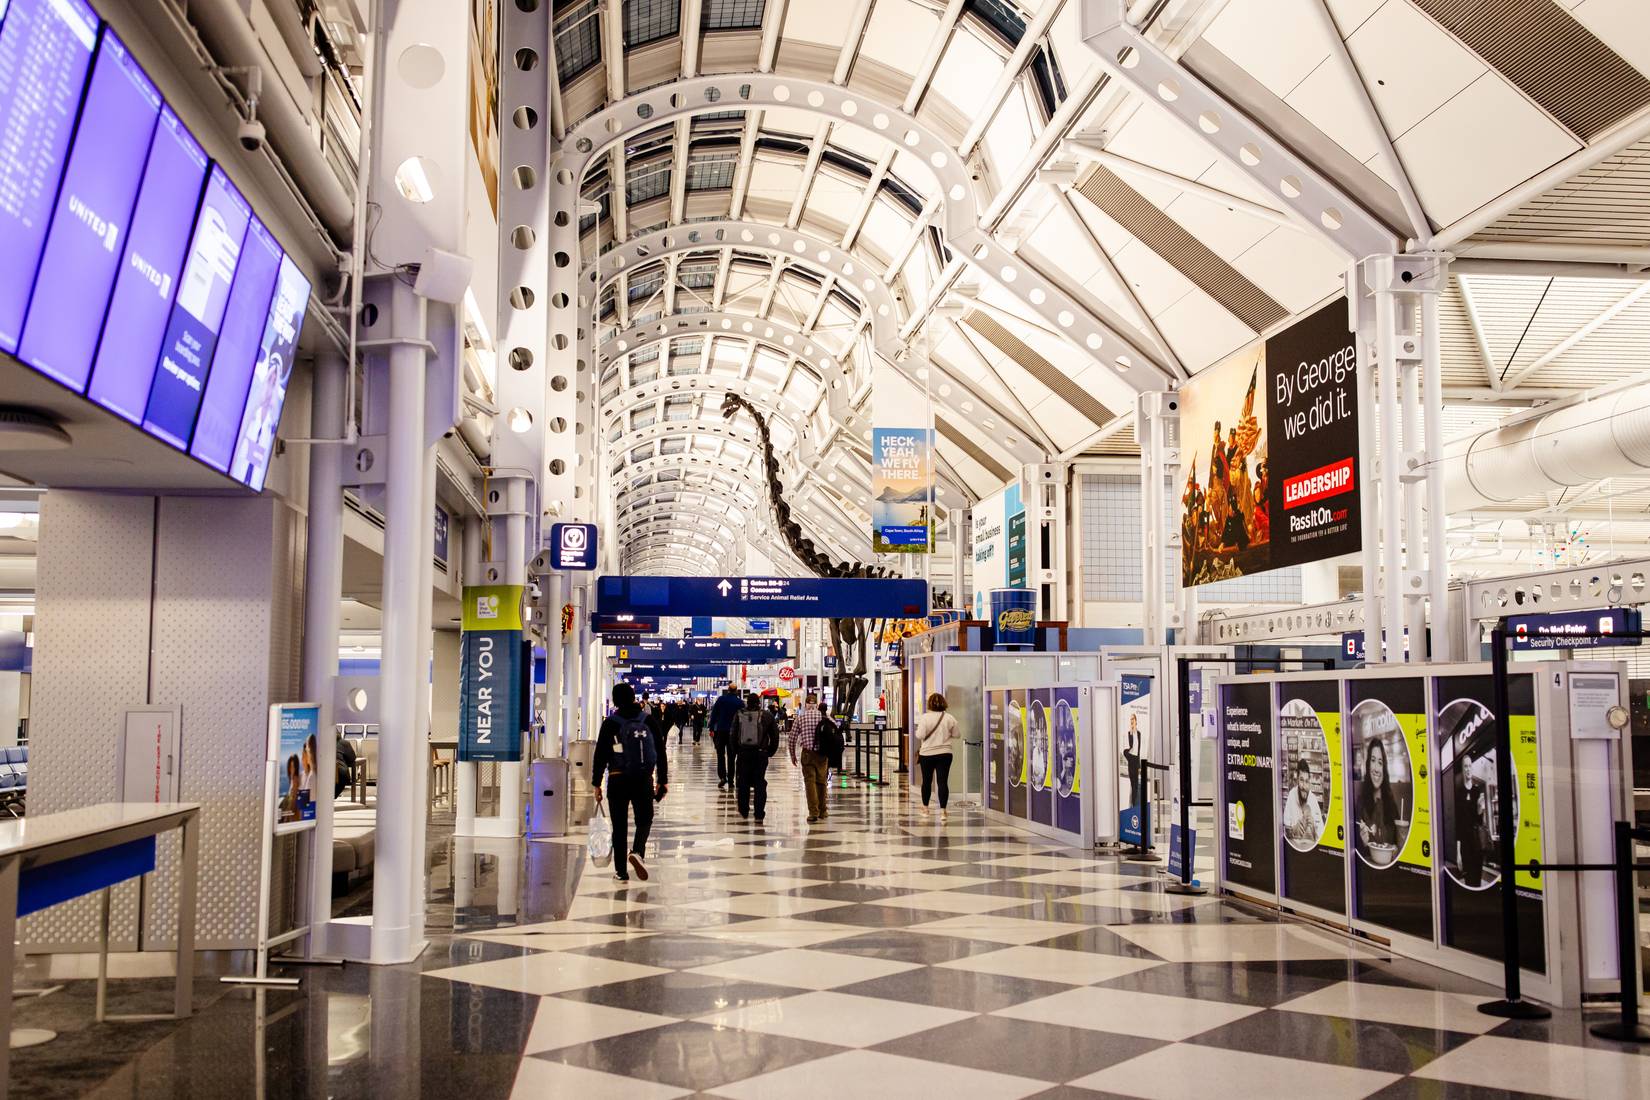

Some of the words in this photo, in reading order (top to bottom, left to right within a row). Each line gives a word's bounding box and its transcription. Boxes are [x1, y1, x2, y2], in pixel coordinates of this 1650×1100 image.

[69, 194, 107, 237] UNITED
[131, 252, 162, 287] UNITED
[1276, 372, 1295, 407] By
[1296, 345, 1355, 394] George
[1284, 412, 1307, 440] we
[1309, 391, 1334, 431] did
[1336, 387, 1351, 420] it.
[881, 436, 915, 446] HECK
[881, 447, 919, 458] YEAH,
[881, 458, 901, 468] WE
[902, 458, 921, 468] FLY
[881, 469, 922, 480] THERE.
[1285, 466, 1351, 503] LEADERSHIP
[1290, 507, 1348, 533] PassItOn.com
[975, 532, 985, 544] small
[985, 525, 1001, 541] business
[1530, 637, 1555, 648] Security
[1555, 636, 1592, 647] Checkpoint
[478, 637, 494, 682] YOU
[1554, 673, 1561, 686] 4
[477, 687, 493, 744] NEAR
[1226, 706, 1248, 717] Experience
